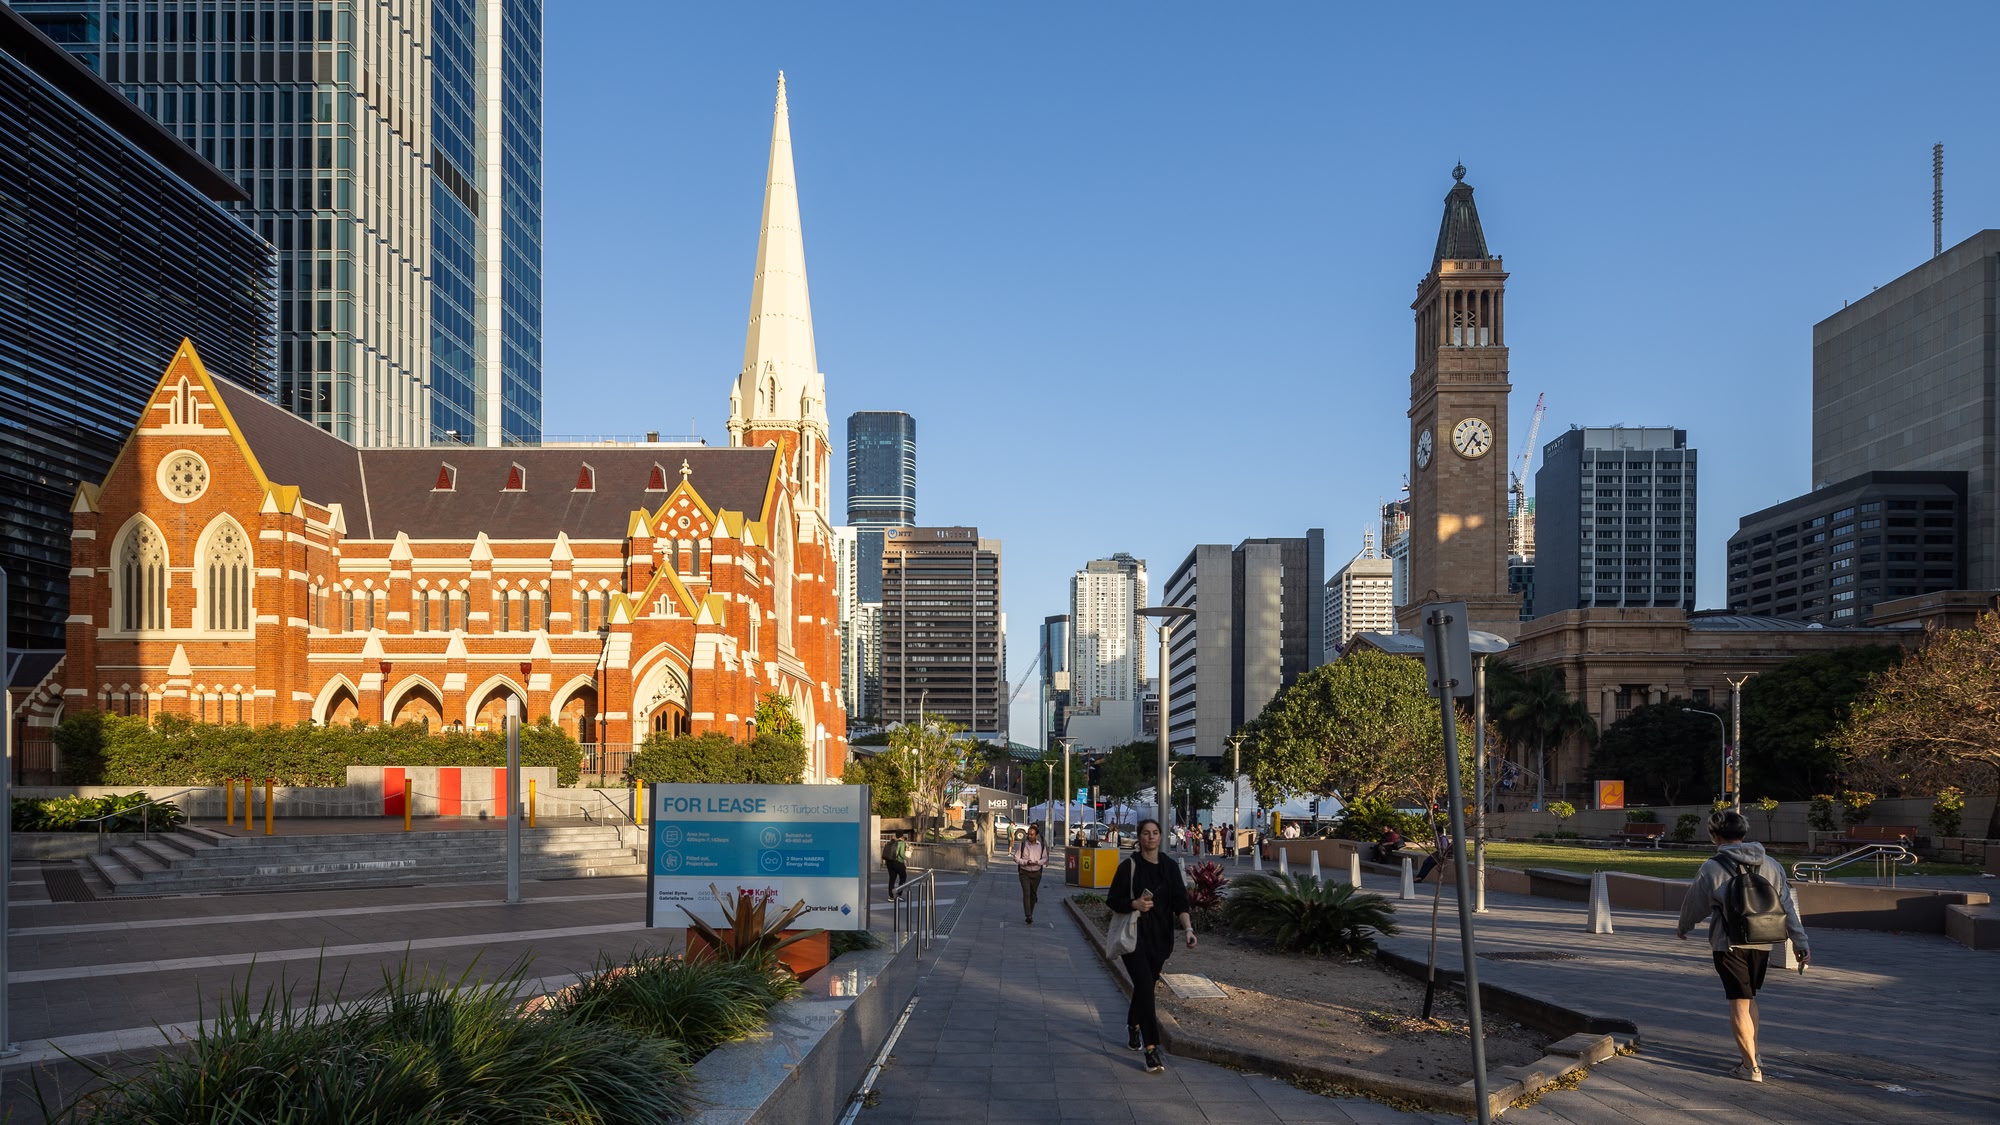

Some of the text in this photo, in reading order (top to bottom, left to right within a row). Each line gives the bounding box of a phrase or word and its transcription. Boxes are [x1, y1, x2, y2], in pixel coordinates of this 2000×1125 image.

[1547, 438, 1564, 453] HYATT
[663, 797, 767, 813] FOR LEASE
[772, 804, 849, 815] 143 Turbot Street
